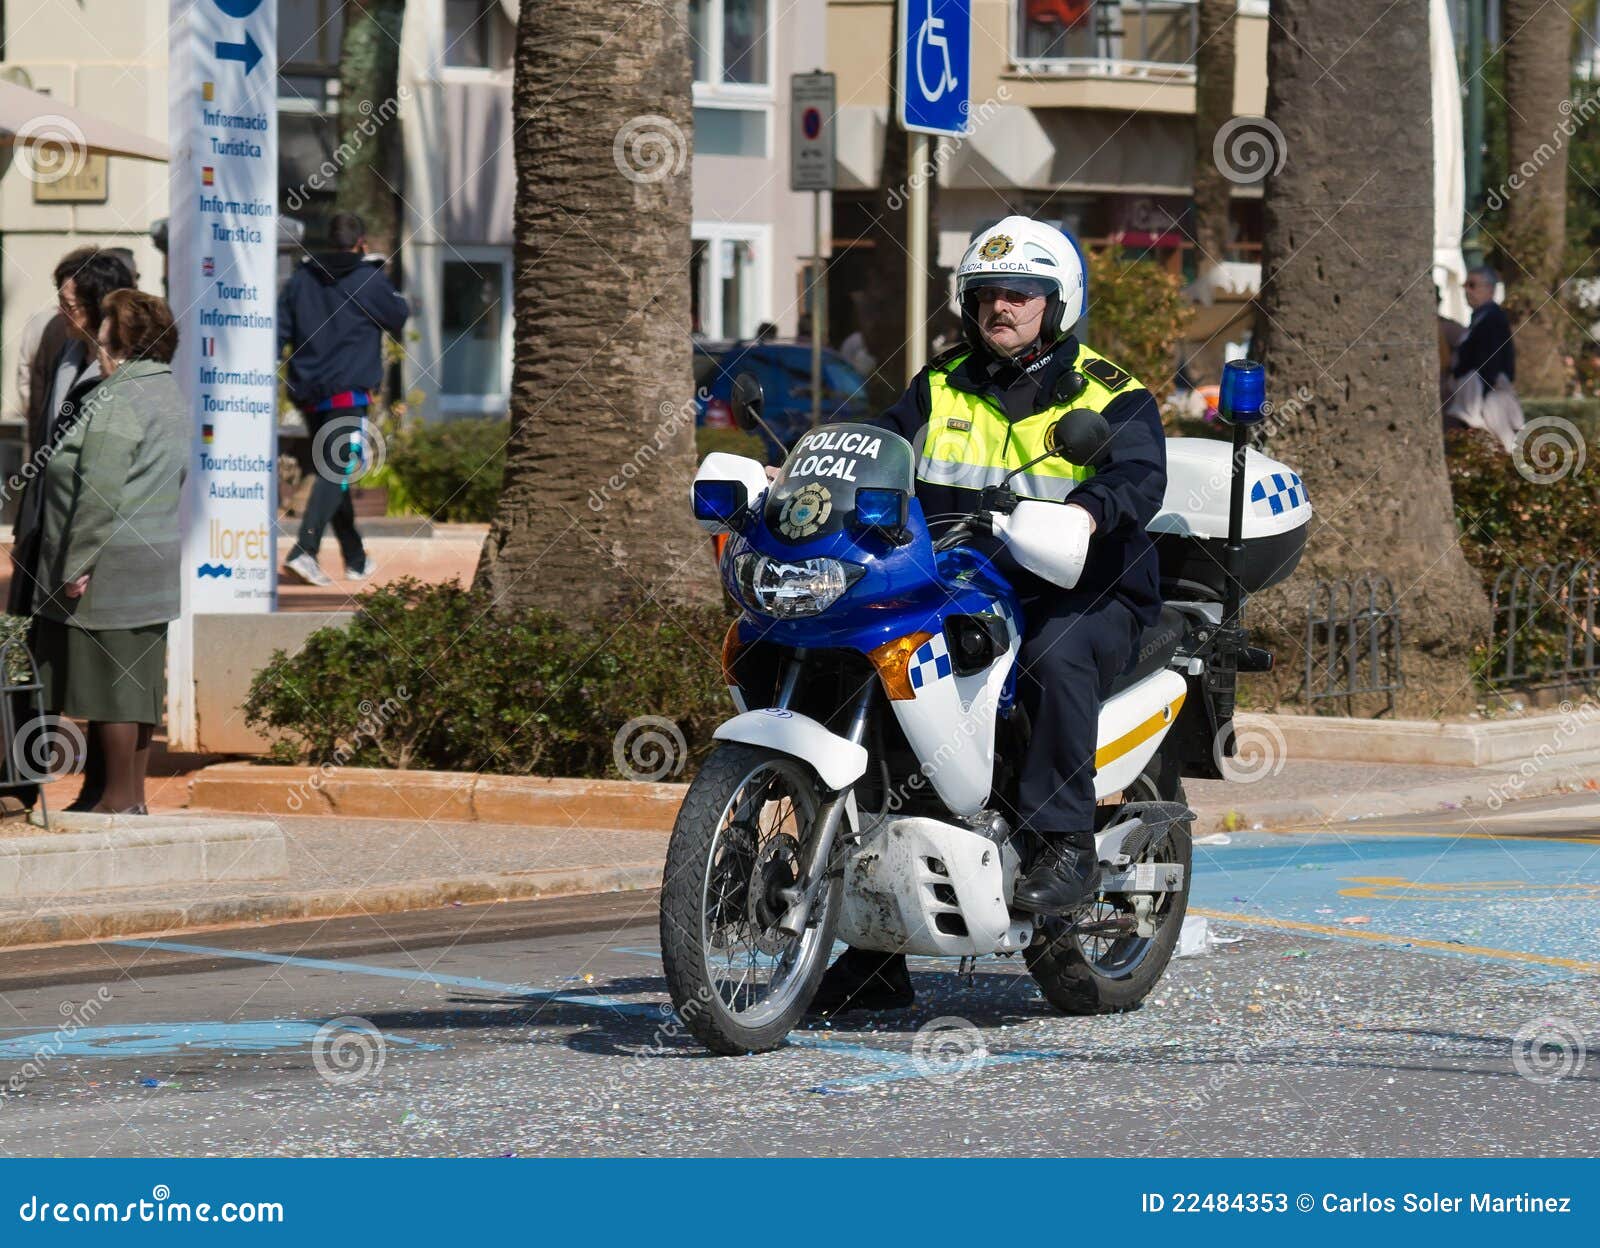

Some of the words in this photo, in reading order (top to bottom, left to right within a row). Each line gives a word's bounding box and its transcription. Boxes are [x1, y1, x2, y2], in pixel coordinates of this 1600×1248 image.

[203, 109, 268, 130] Informació
[200, 195, 272, 217] Información
[991, 262, 1032, 272] LOCAL
[216, 281, 257, 300] Tourist
[200, 308, 272, 329] Information
[200, 366, 272, 387] Information
[202, 394, 271, 418] Touristique
[798, 432, 882, 460] POLICIA
[200, 453, 273, 473] Touristische
[789, 455, 857, 482] LOCAL
[208, 482, 264, 500] Auskunft
[209, 519, 268, 559] lloret
[1138, 630, 1177, 663] HONDA
